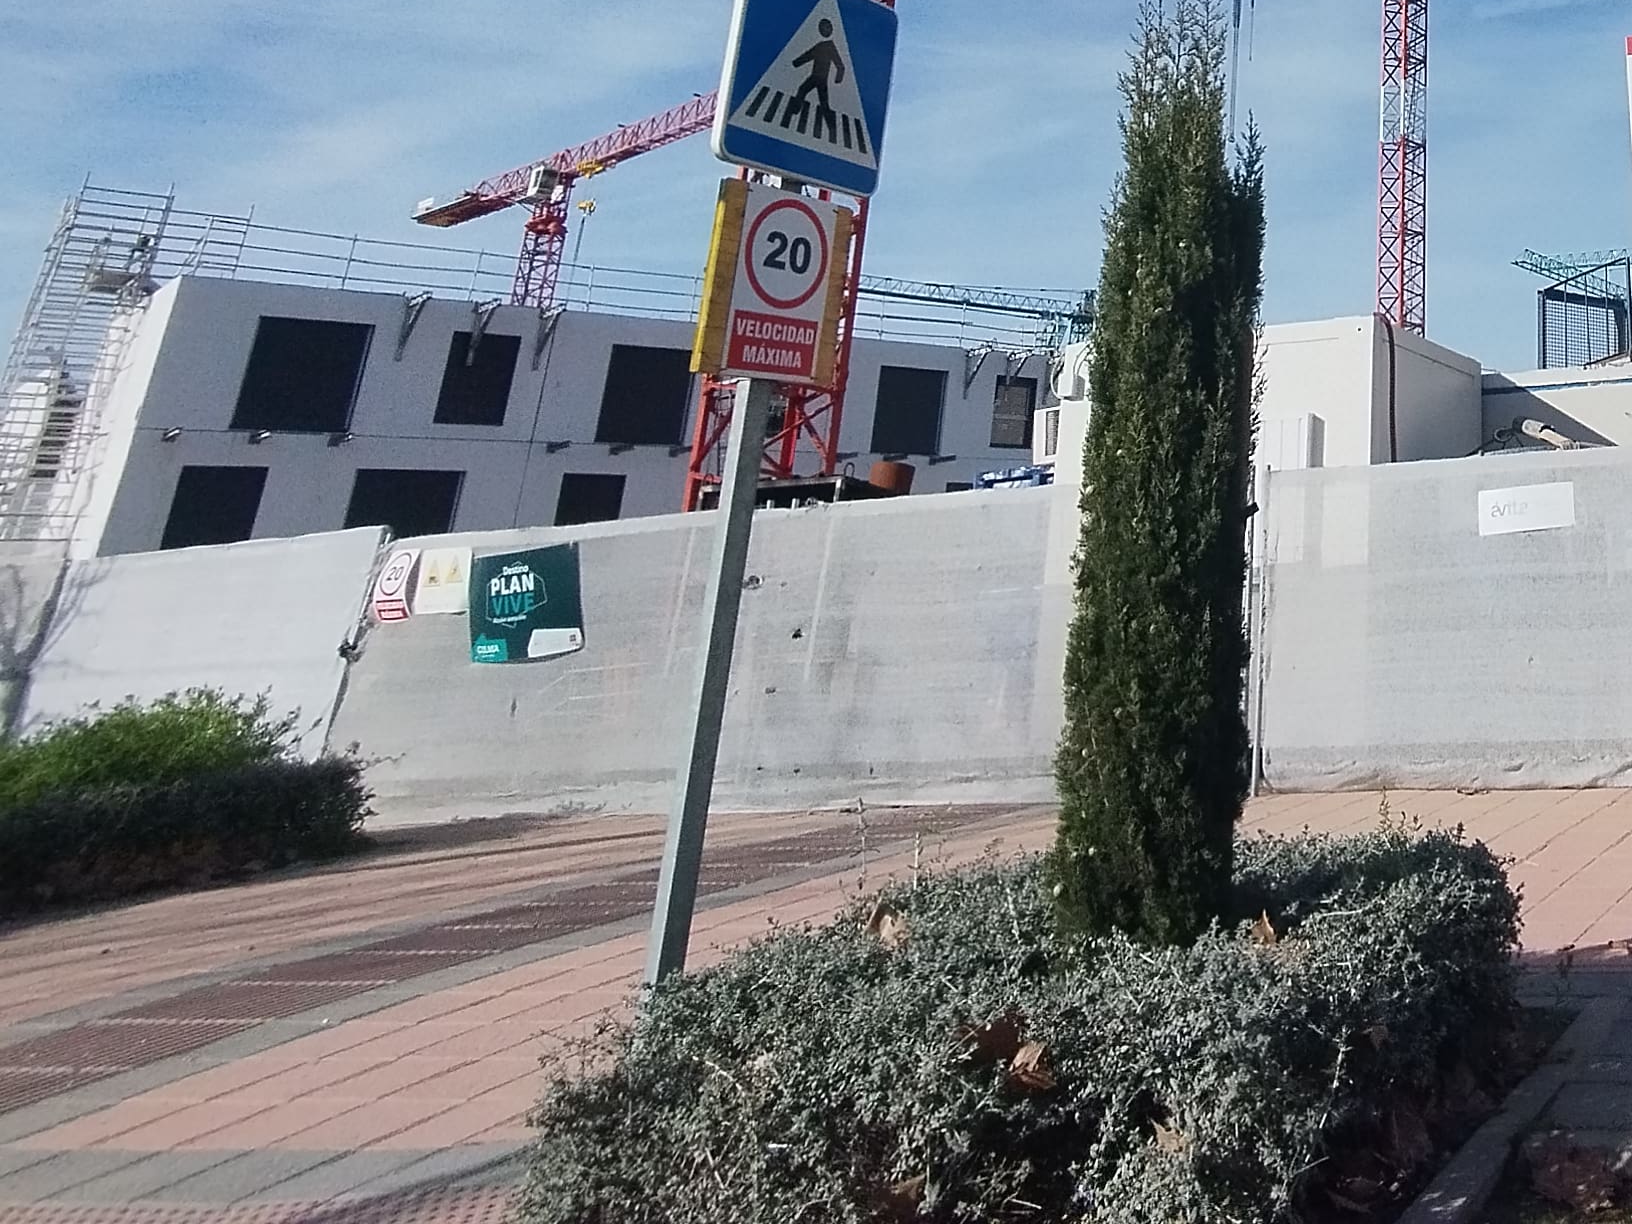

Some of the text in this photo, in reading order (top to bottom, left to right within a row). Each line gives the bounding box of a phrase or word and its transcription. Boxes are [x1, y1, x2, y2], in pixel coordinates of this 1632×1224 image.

[763, 230, 812, 275] 20
[736, 317, 815, 345] VELOCIDAD
[742, 342, 802, 368] MÁXIMA
[385, 566, 405, 581] 20
[490, 573, 534, 596] PLAN
[492, 592, 535, 615] VIVE
